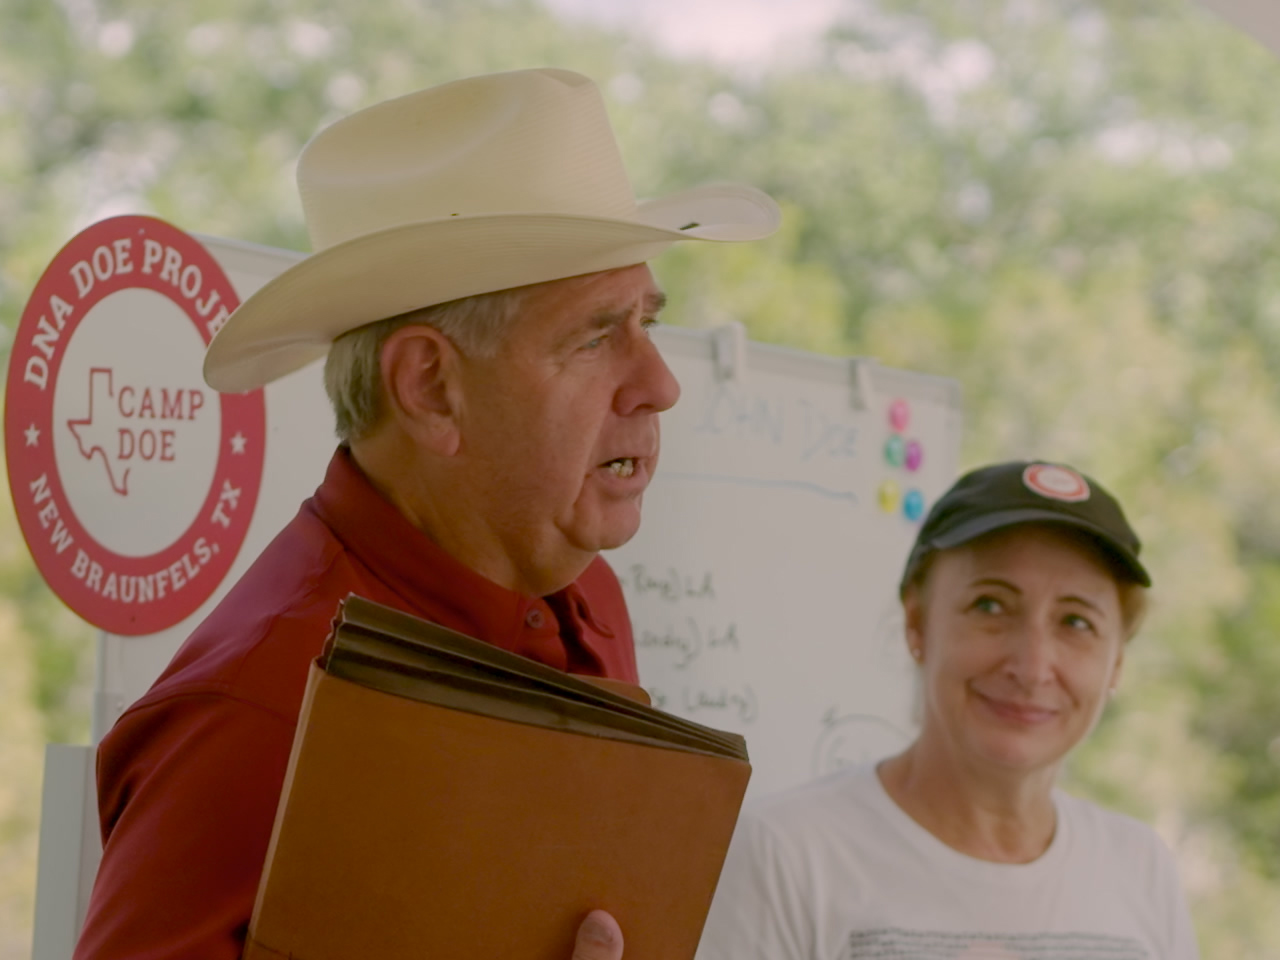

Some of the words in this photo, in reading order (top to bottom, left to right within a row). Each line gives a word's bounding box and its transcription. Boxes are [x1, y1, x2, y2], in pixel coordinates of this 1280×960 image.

[24, 294, 74, 391] DNA
[70, 238, 133, 298] DOE
[142, 239, 232, 338] PROJE
[118, 386, 205, 421] CAMP
[118, 428, 175, 462] DOE
[29, 473, 74, 555] NEW
[70, 537, 220, 604] BRAUNFELS,
[211, 479, 242, 529] TX
